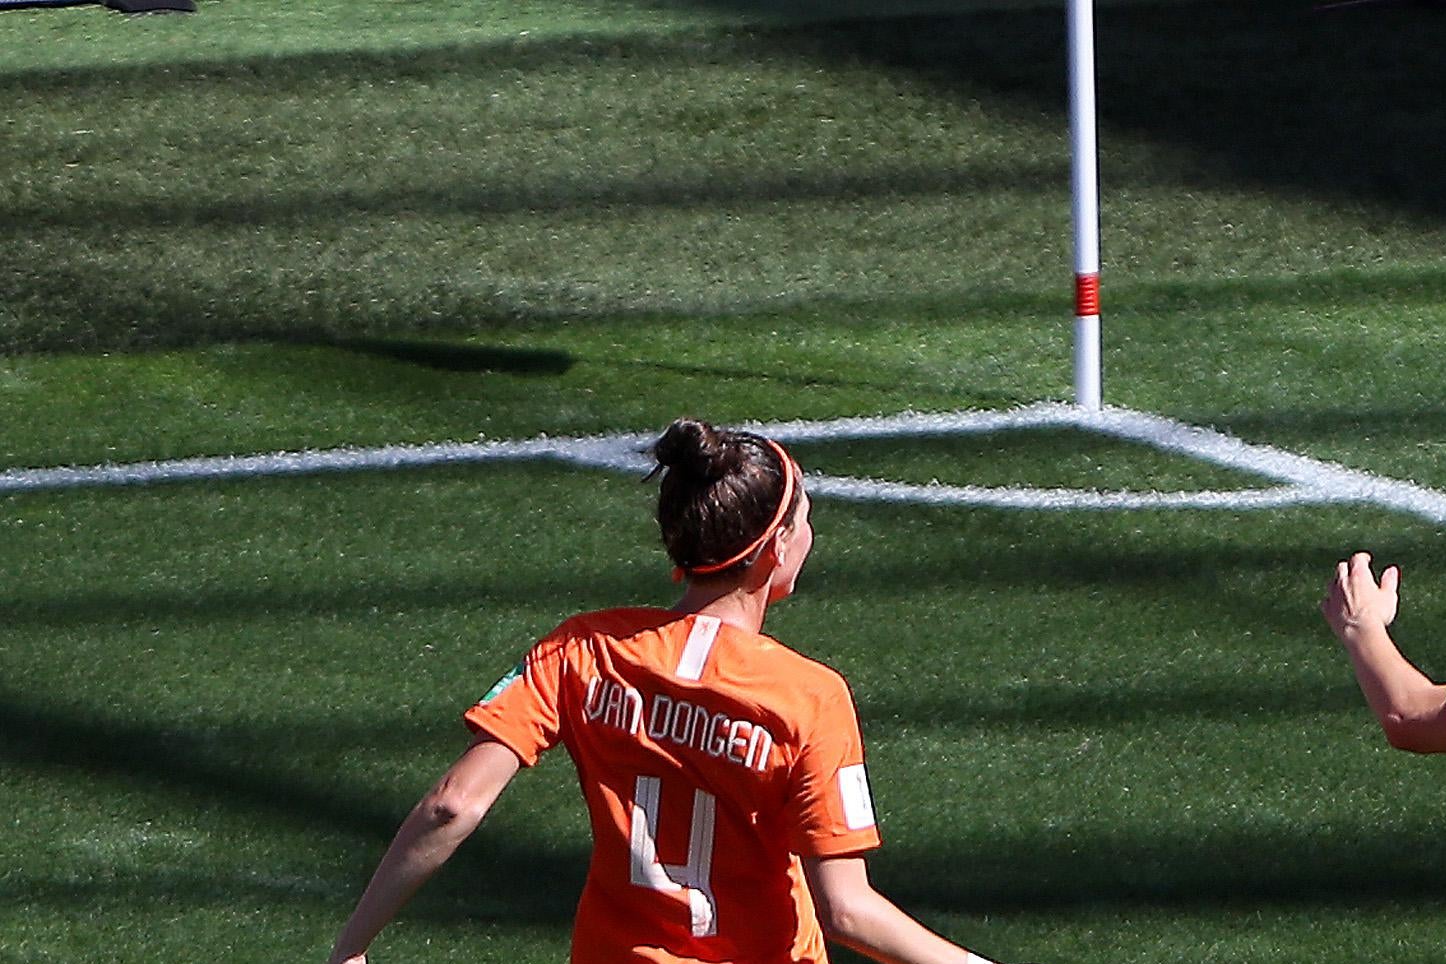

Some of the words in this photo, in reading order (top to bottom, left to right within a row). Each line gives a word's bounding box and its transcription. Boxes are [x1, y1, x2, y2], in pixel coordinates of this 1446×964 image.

[585, 675, 642, 735] VAN
[649, 694, 772, 772] DONGEN
[631, 775, 717, 938] 4
